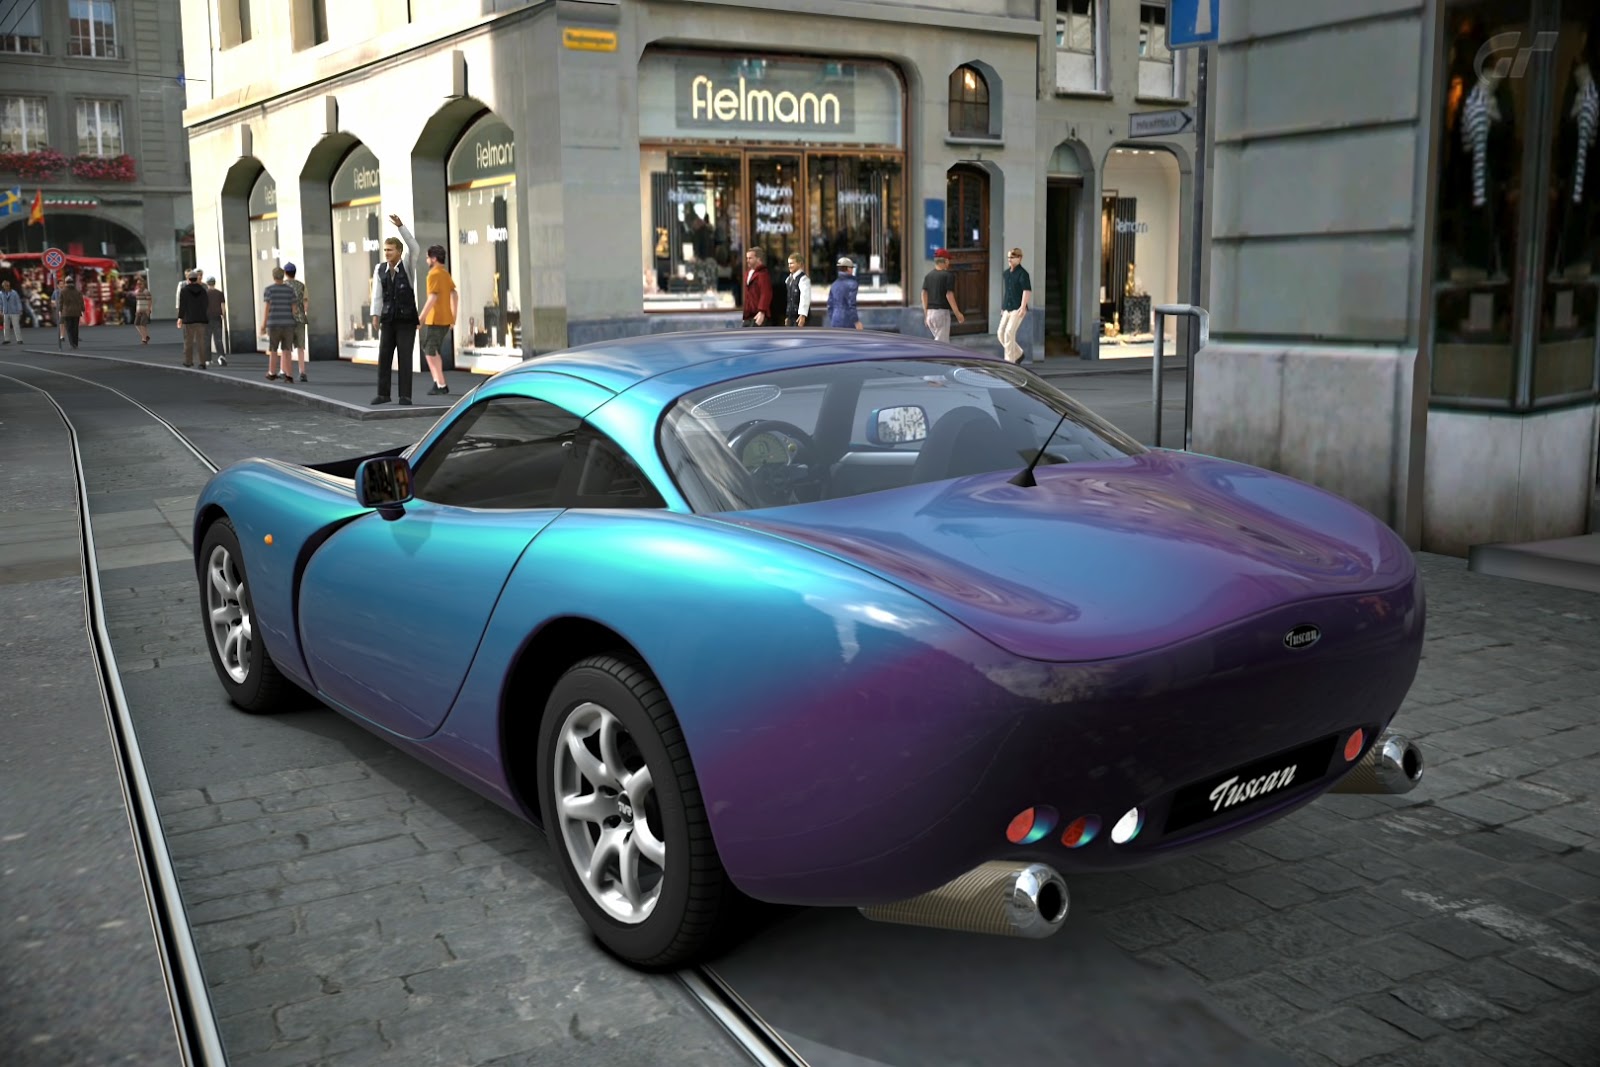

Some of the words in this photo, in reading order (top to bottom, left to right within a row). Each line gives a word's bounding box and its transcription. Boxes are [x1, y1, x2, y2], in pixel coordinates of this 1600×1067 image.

[692, 74, 840, 125] fielmann
[1285, 630, 1317, 647] Tuscan
[1209, 764, 1297, 812] Tuscan
